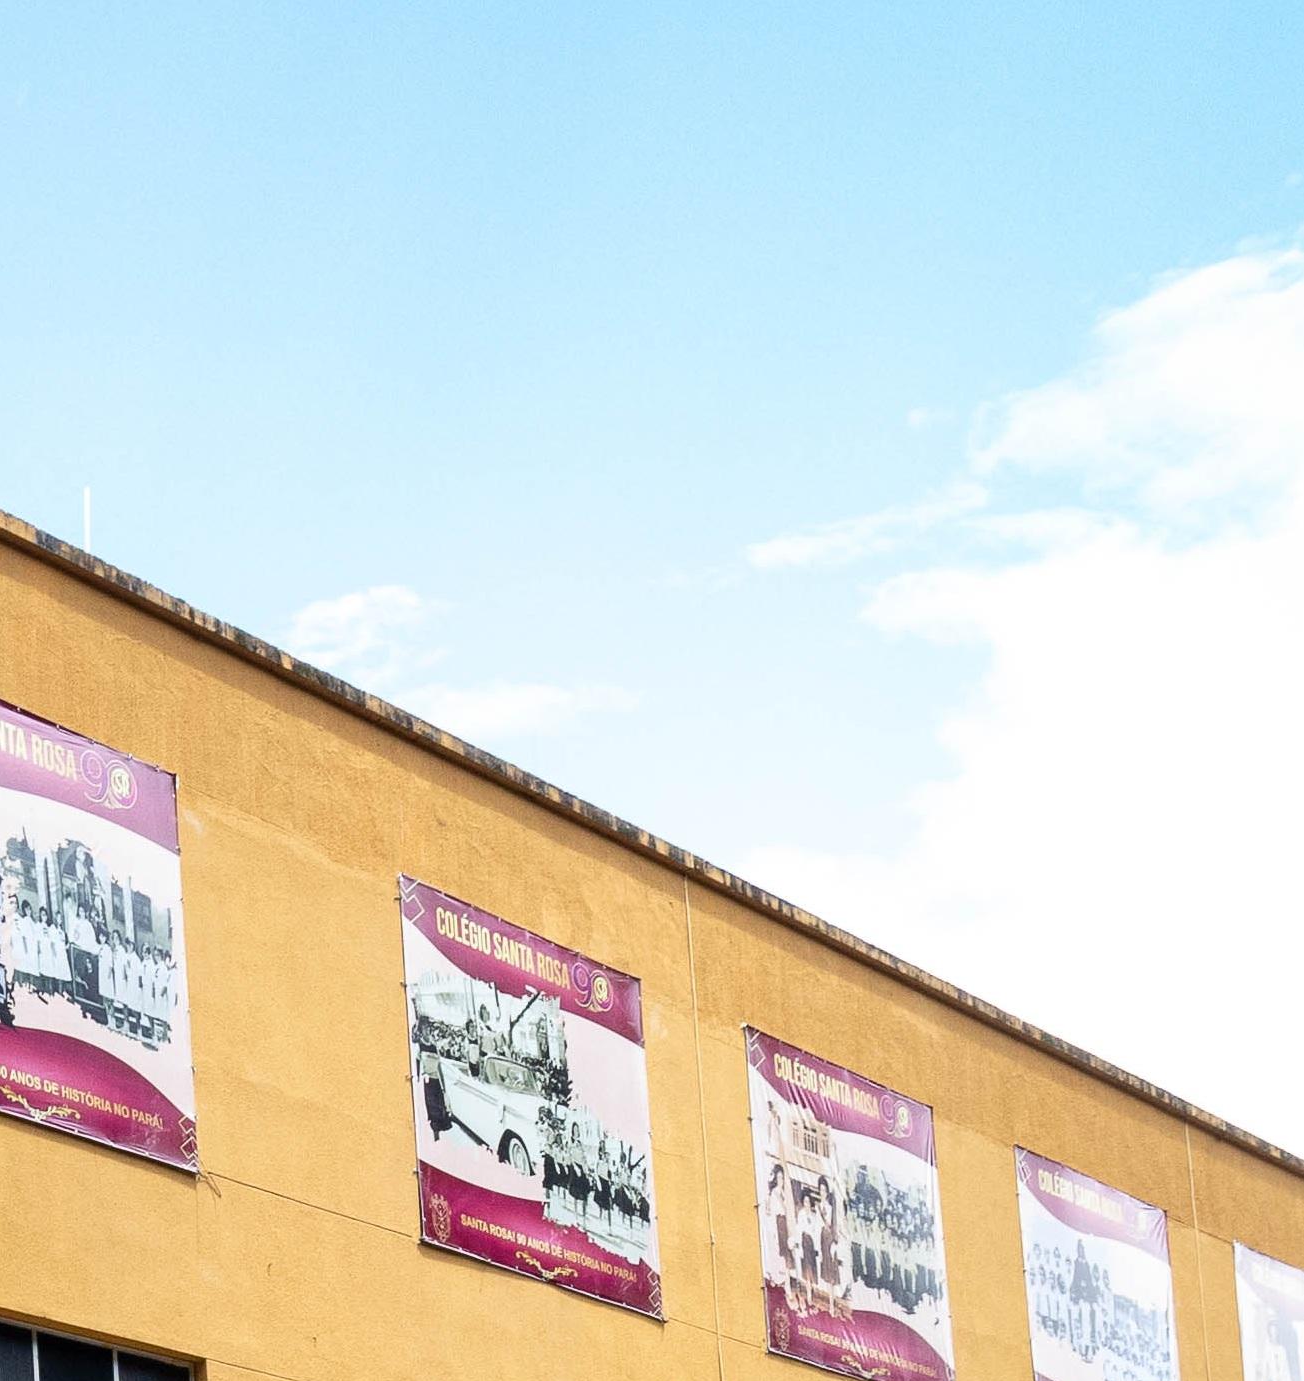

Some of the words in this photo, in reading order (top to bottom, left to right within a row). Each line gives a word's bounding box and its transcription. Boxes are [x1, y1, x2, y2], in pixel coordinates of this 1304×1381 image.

[31, 733, 78, 781] ROSA
[436, 906, 491, 955] COLÉGIO
[493, 931, 534, 973] SANTA
[537, 951, 571, 990] ROSA
[9, 1065, 42, 1091] ANOS
[44, 1078, 60, 1097] DE
[61, 1083, 112, 1113] HISTÓRIA
[113, 1101, 130, 1119] NO
[774, 1053, 818, 1093] COLÉGIO
[819, 1073, 853, 1106] SANTA
[854, 1087, 880, 1120] ROSA
[460, 1214, 490, 1233] SANTA
[551, 1244, 564, 1259] DE
